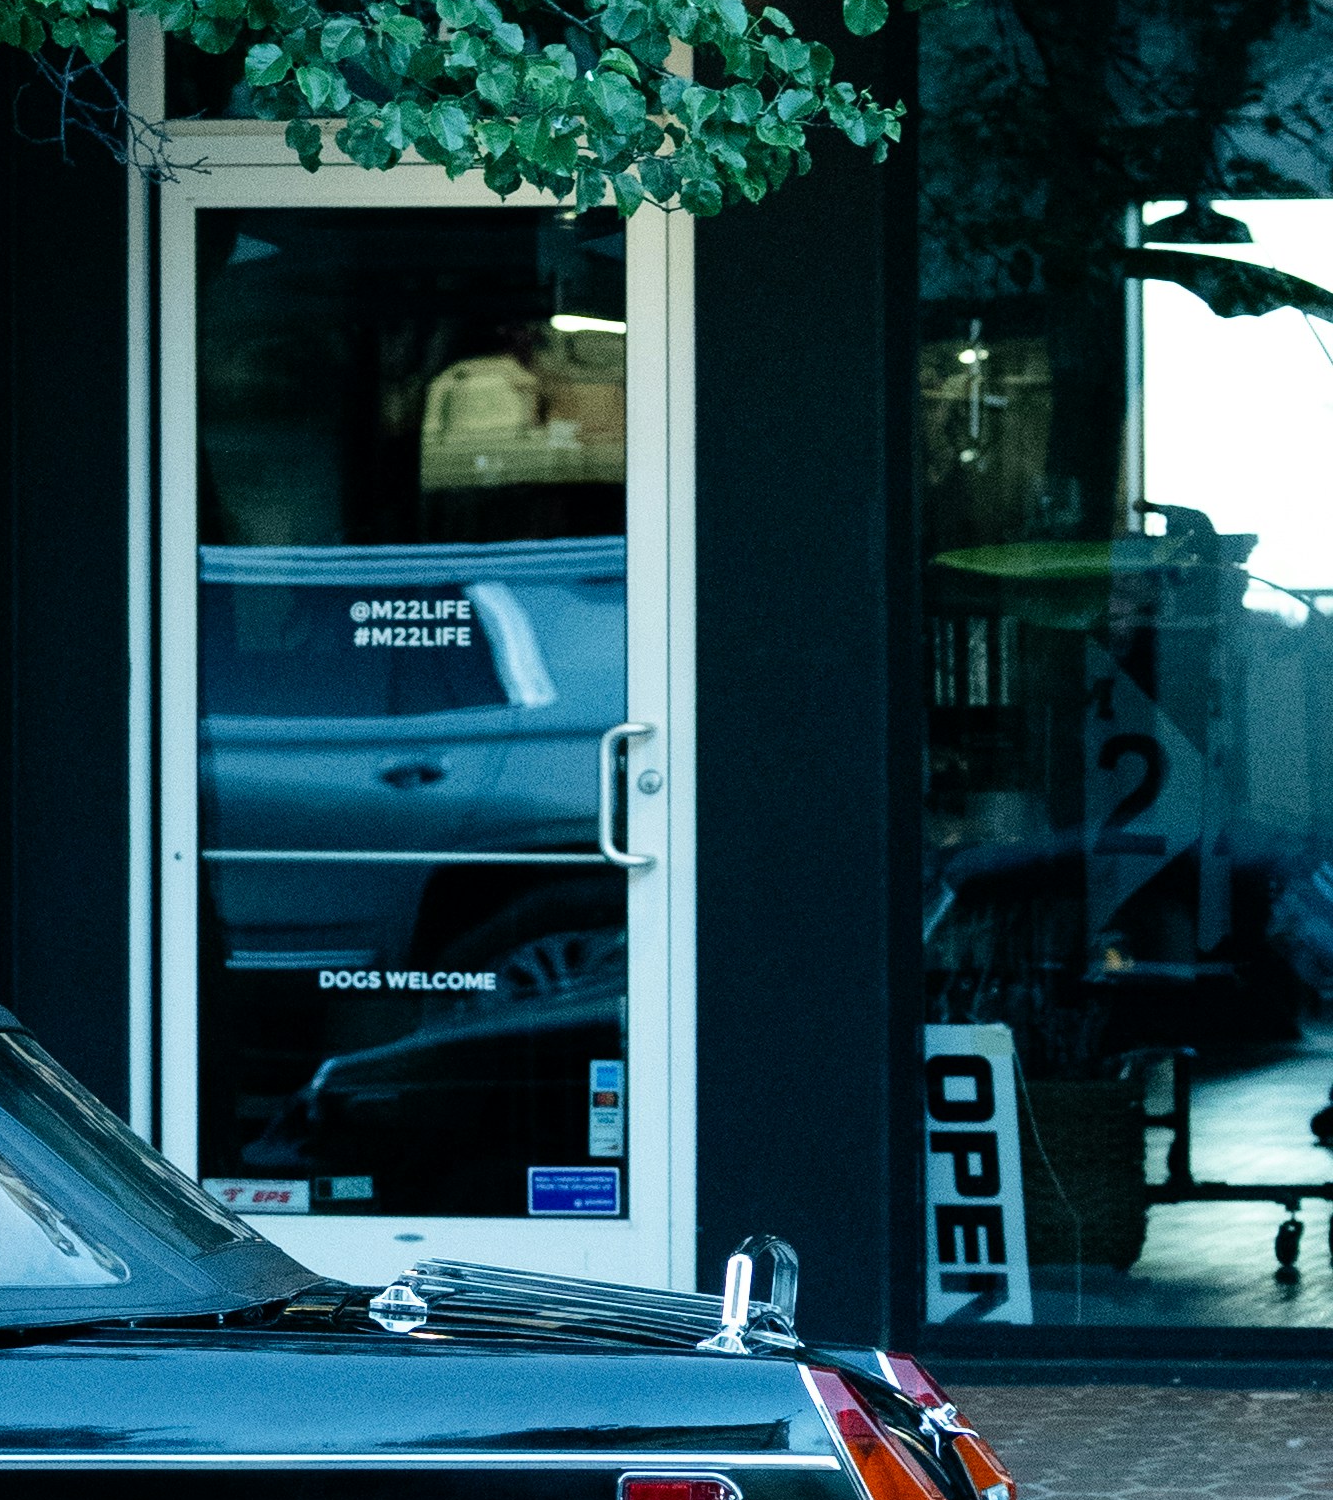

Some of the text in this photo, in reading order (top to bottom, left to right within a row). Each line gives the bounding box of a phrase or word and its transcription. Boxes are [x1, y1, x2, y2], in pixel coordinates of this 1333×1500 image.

[349, 600, 472, 622] @M22LIFE
[353, 627, 472, 647] #M22LIFE
[318, 970, 497, 991] DOGS WELCOME
[926, 1055, 1010, 1323] OPEN
